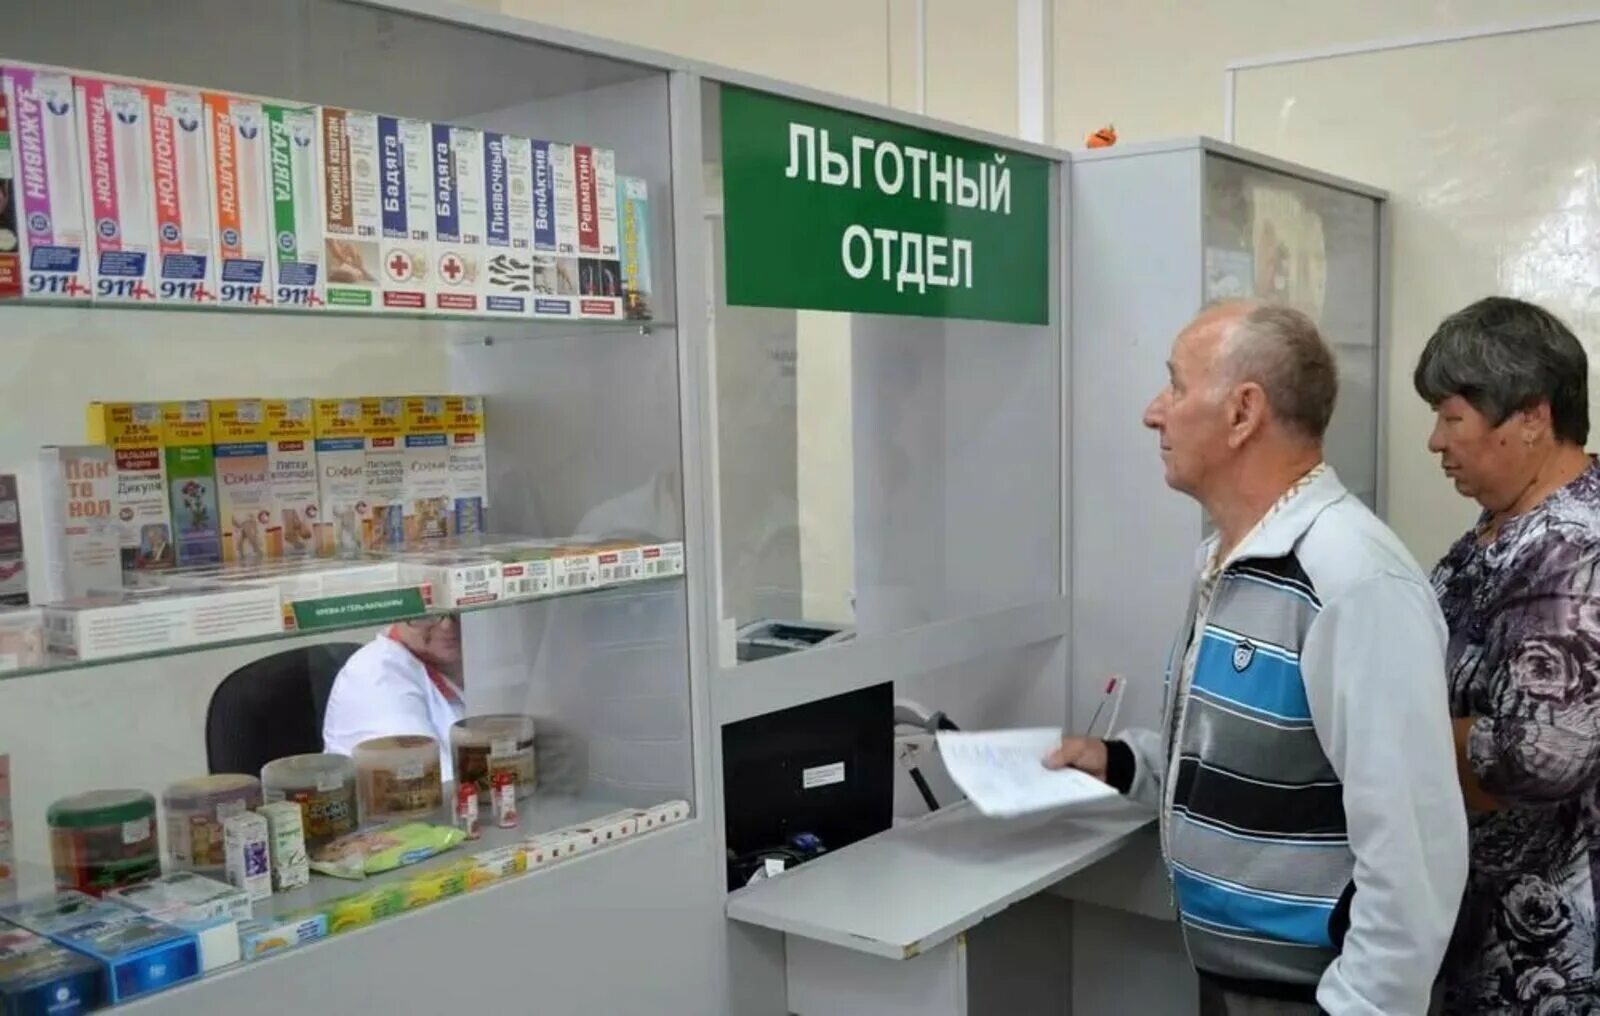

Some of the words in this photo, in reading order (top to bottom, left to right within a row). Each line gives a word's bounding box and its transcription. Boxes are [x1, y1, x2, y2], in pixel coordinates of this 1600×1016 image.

[18, 84, 46, 199] ЗАЖИВИН
[153, 104, 174, 207] ВЕНОЛГОН
[217, 113, 235, 213] РЕВМАЛГОН
[270, 119, 292, 202] БАДЯГА
[384, 135, 400, 212] Бадяга
[437, 142, 451, 216] Бадяга
[785, 122, 1011, 215] ЛЬГОТНЫЙ
[489, 141, 505, 234] Пиявочный
[535, 150, 549, 230] ВенАктив
[578, 154, 592, 232] Ревматин
[841, 224, 972, 294] ОТДЕЛ
